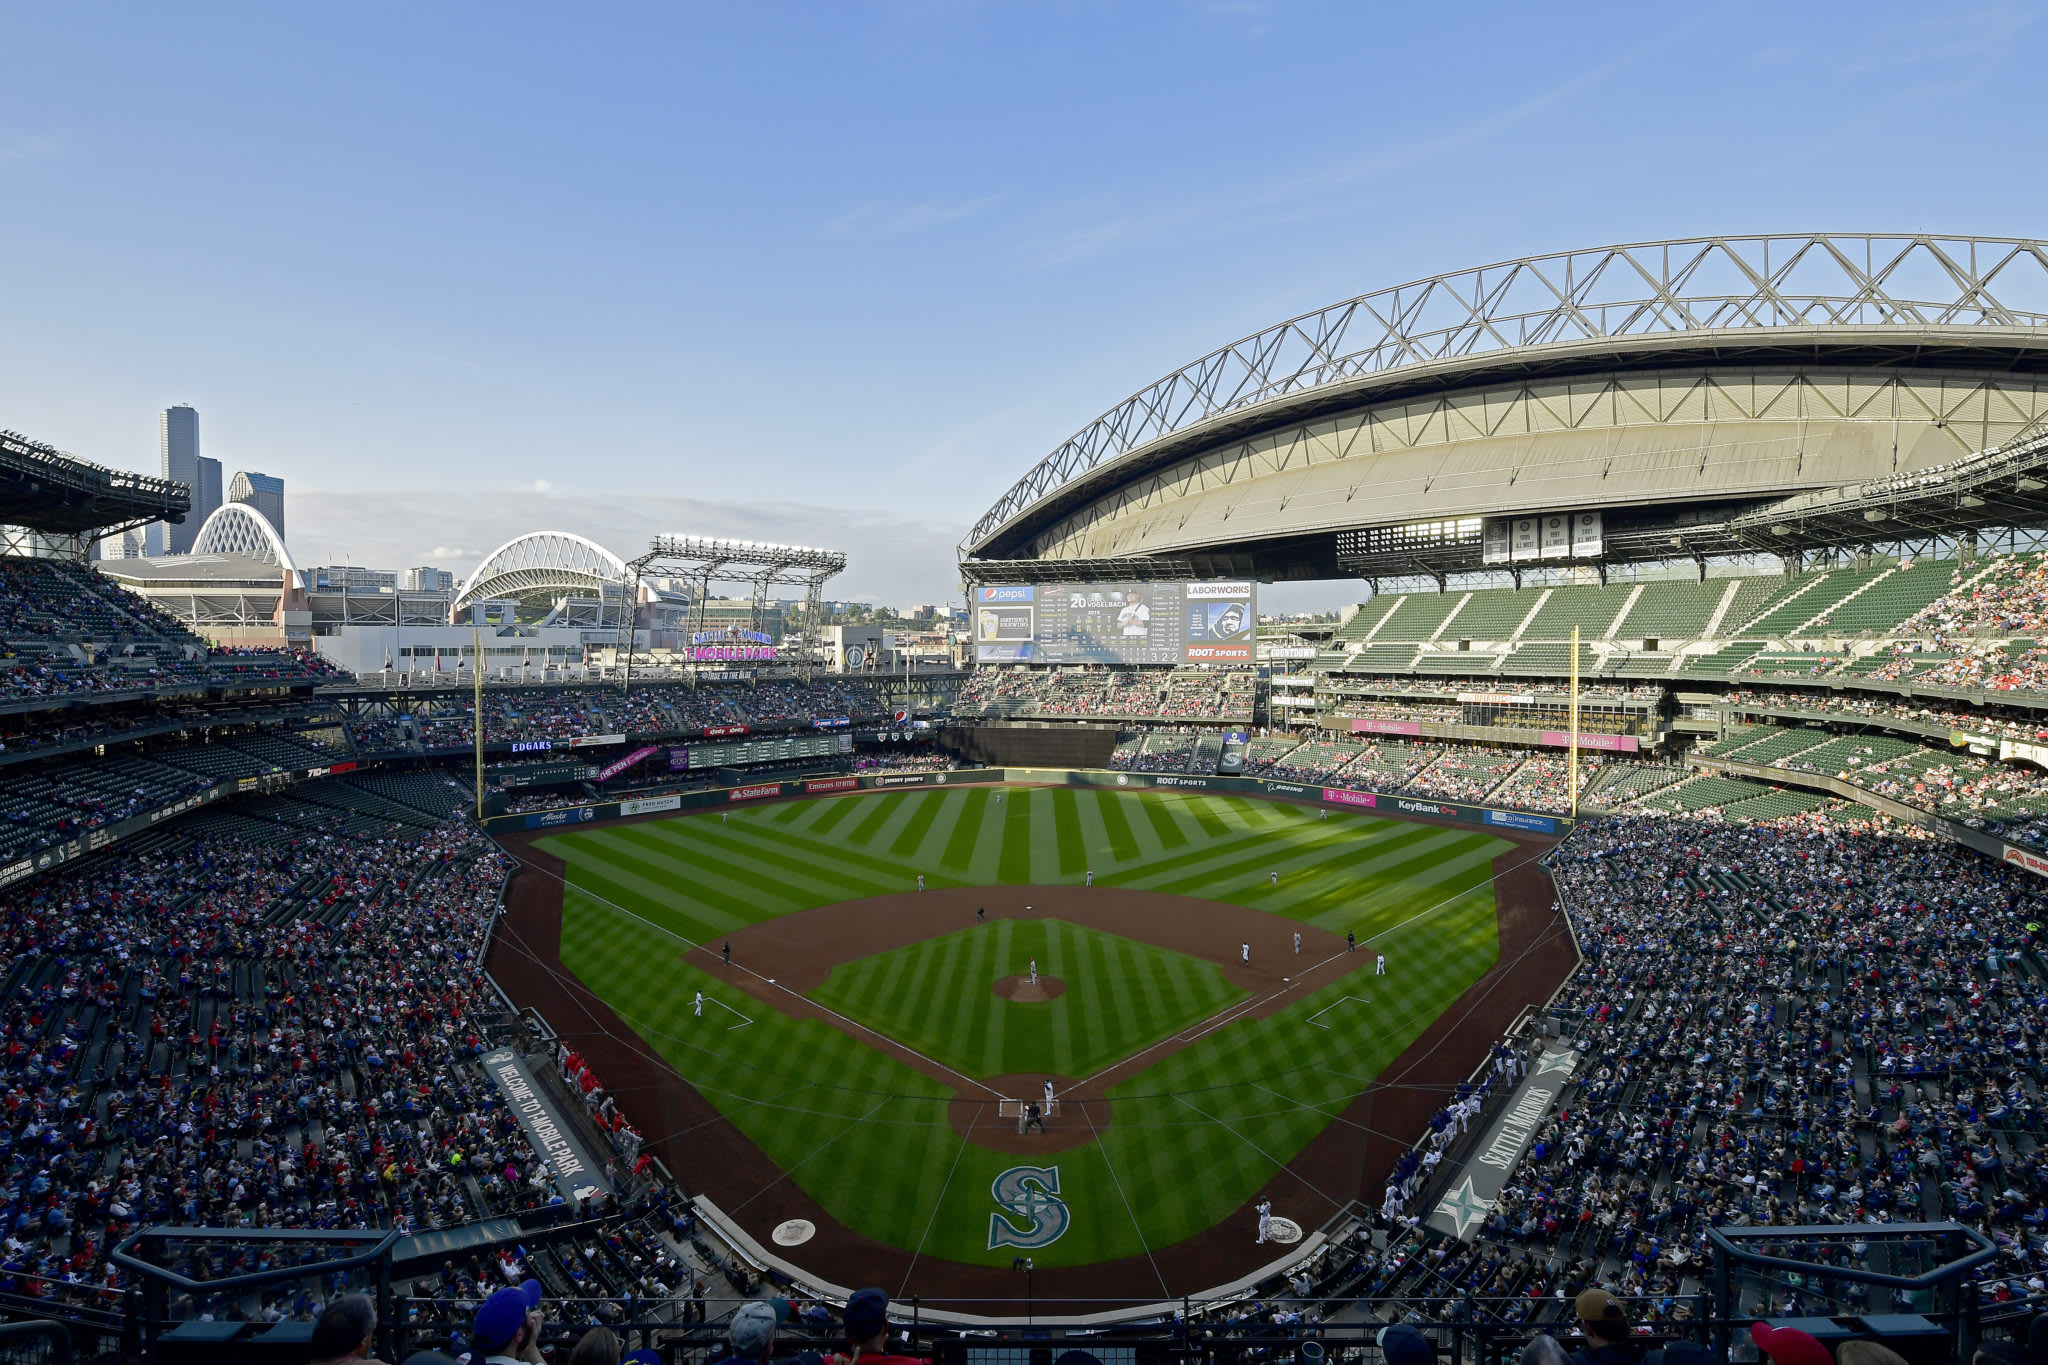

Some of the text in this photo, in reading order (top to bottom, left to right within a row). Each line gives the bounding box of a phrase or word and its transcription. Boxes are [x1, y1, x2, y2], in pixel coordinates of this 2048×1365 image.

[999, 589, 1025, 599] pepsi
[1188, 586, 1249, 594] LABORWORKS
[1070, 598, 1086, 608] 20
[685, 648, 777, 660] T-MOBILE PARK
[1152, 652, 1157, 662] 3
[1162, 652, 1168, 662] 2
[1172, 652, 1178, 662] 2
[1188, 648, 1215, 656] ROOT
[708, 672, 720, 680] TRUE
[739, 671, 752, 679] BLUE
[308, 768, 321, 778] 710
[600, 768, 612, 779] THE
[809, 782, 834, 790] Emirates
[1399, 800, 1440, 814] KeyBank
[540, 812, 567, 821] Alaska
[1493, 812, 1543, 824] Safeco Insurance
[2, 866, 15, 875] TEAM
[15, 860, 32, 872] STORES
[10, 872, 20, 881] YEAR
[21, 866, 34, 877] ROUND
[497, 1064, 584, 1178] WELCOME TO T-MOBILE PARK
[1479, 1086, 1552, 1170] SEATTLE MARINERS
